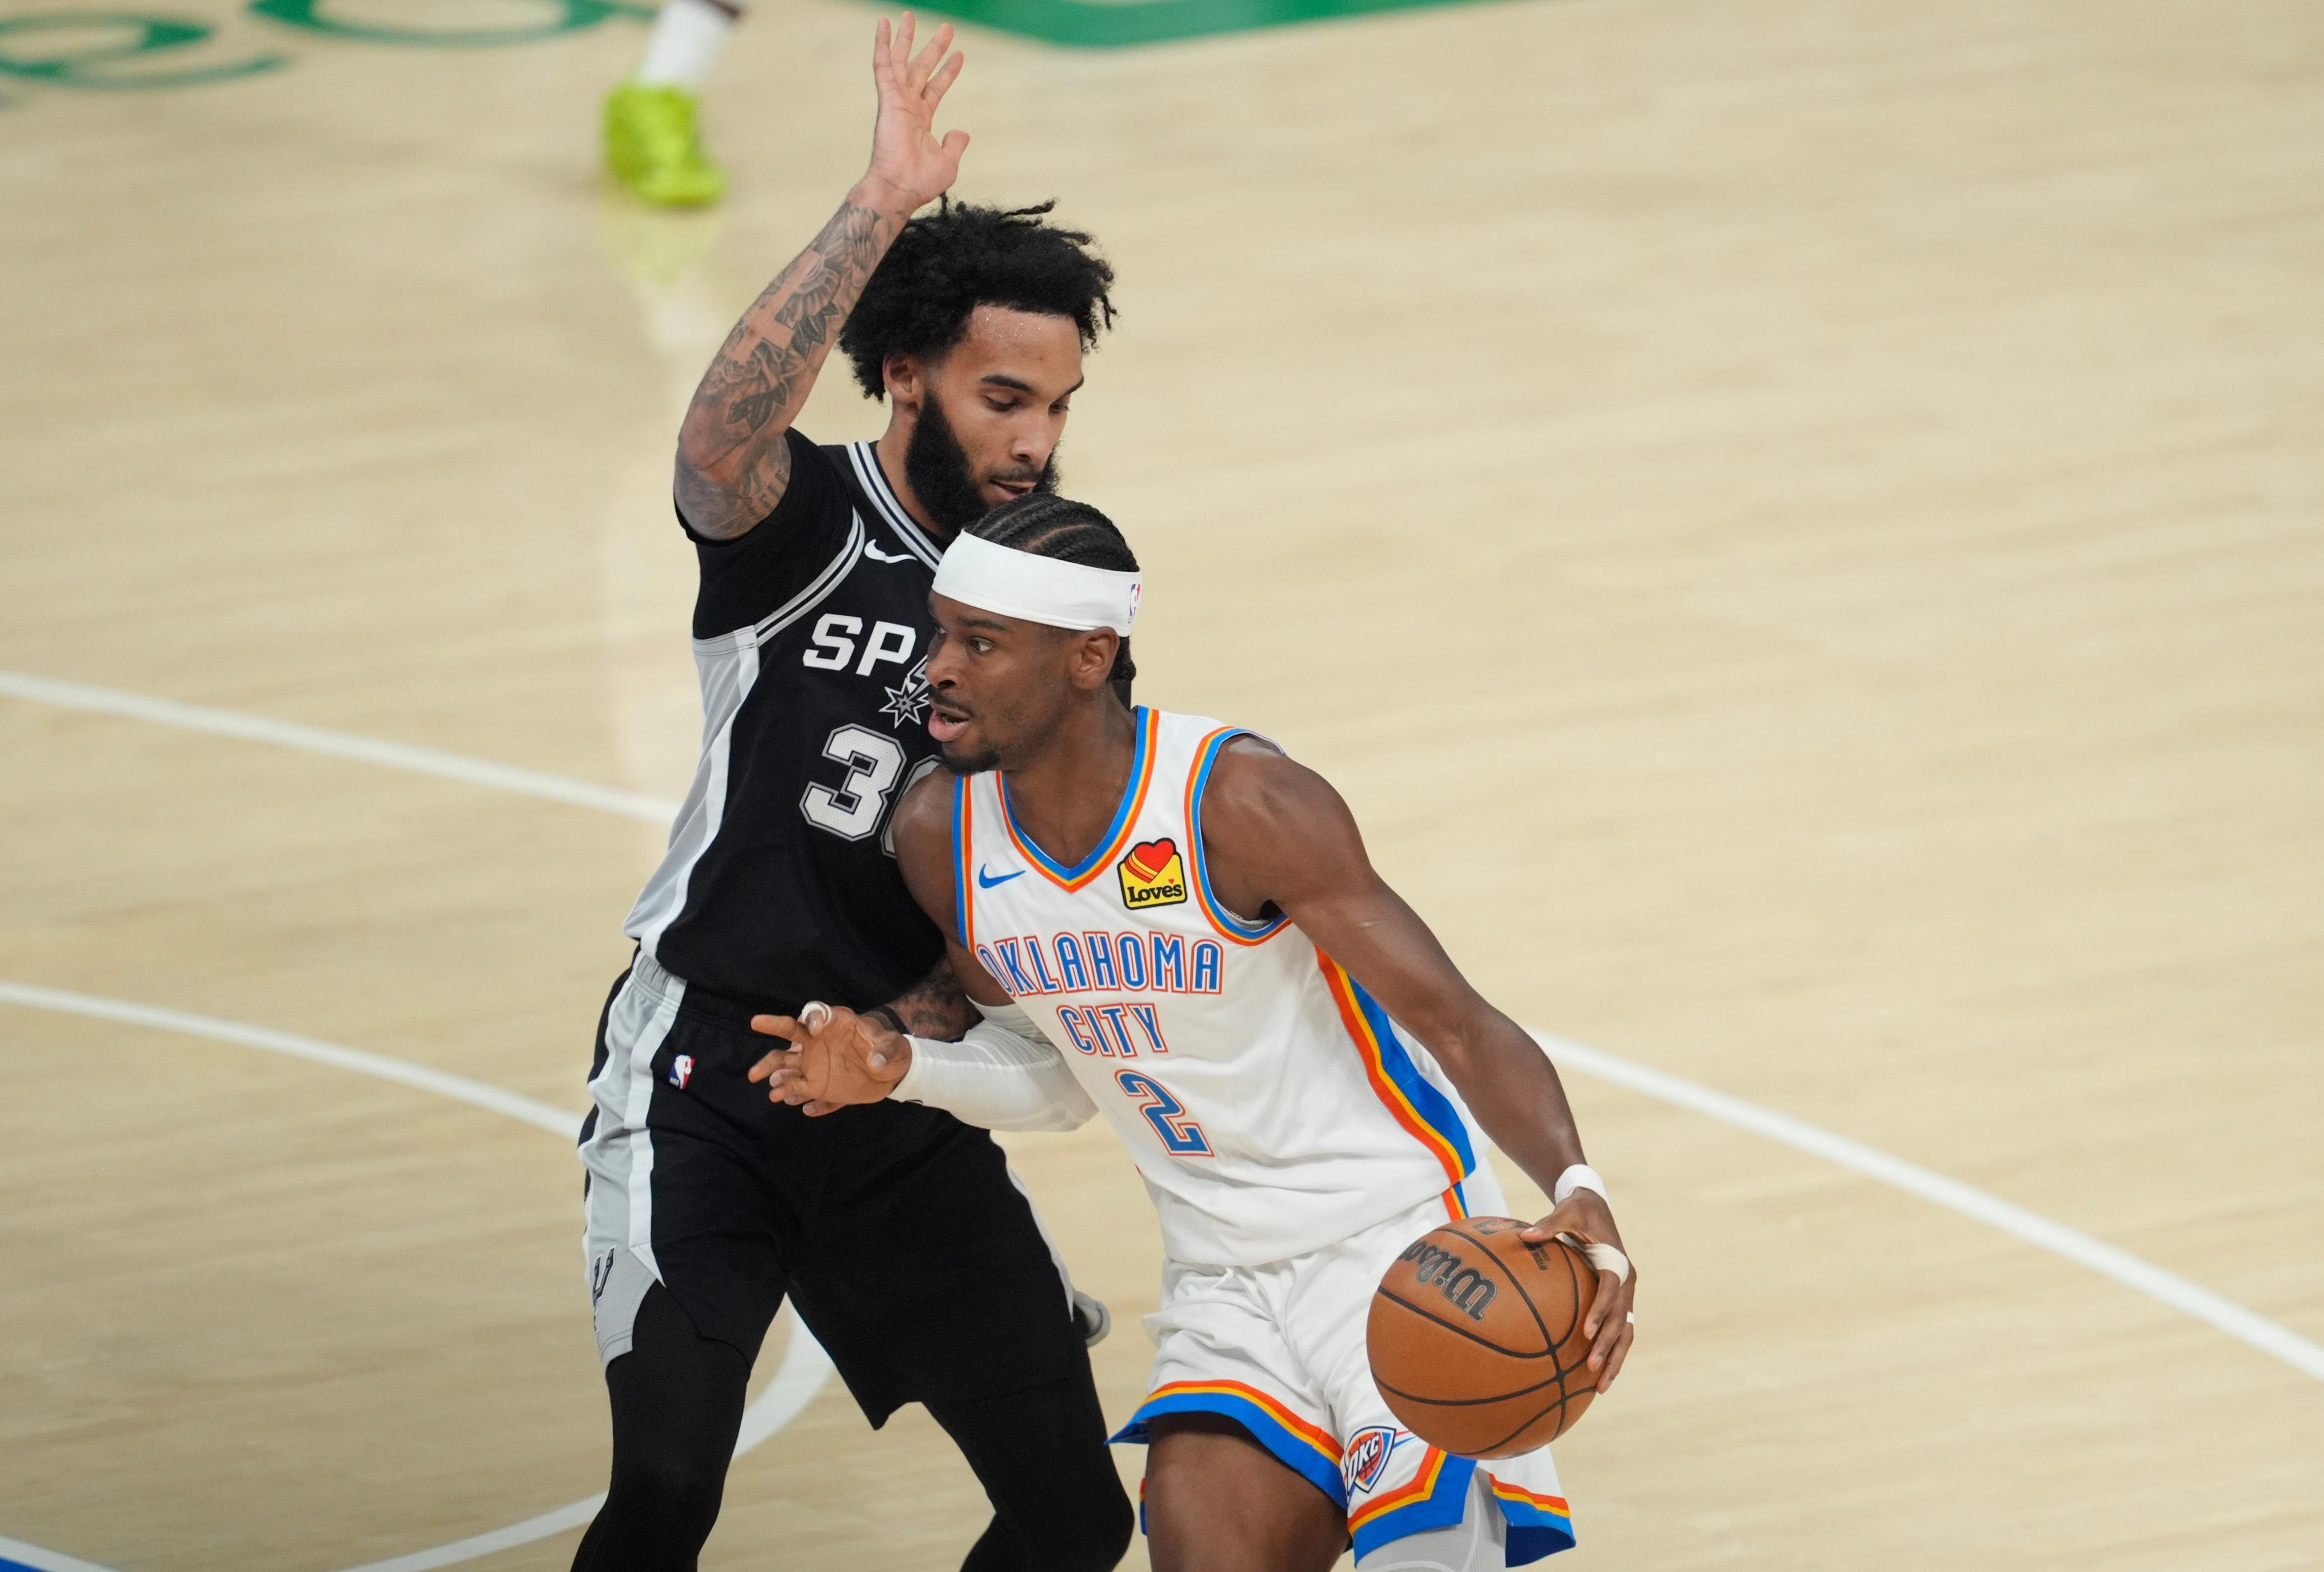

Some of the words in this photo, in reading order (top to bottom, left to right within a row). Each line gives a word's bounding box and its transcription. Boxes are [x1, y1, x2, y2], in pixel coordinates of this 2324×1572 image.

[799, 723, 942, 859] 3
[976, 931, 1224, 998] OKLAHOMA
[1056, 1003, 1169, 1058] CITY
[1114, 1069, 1215, 1157] 2
[1397, 1241, 1498, 1323] Wilso
[1347, 1435, 1380, 1492] OKC
